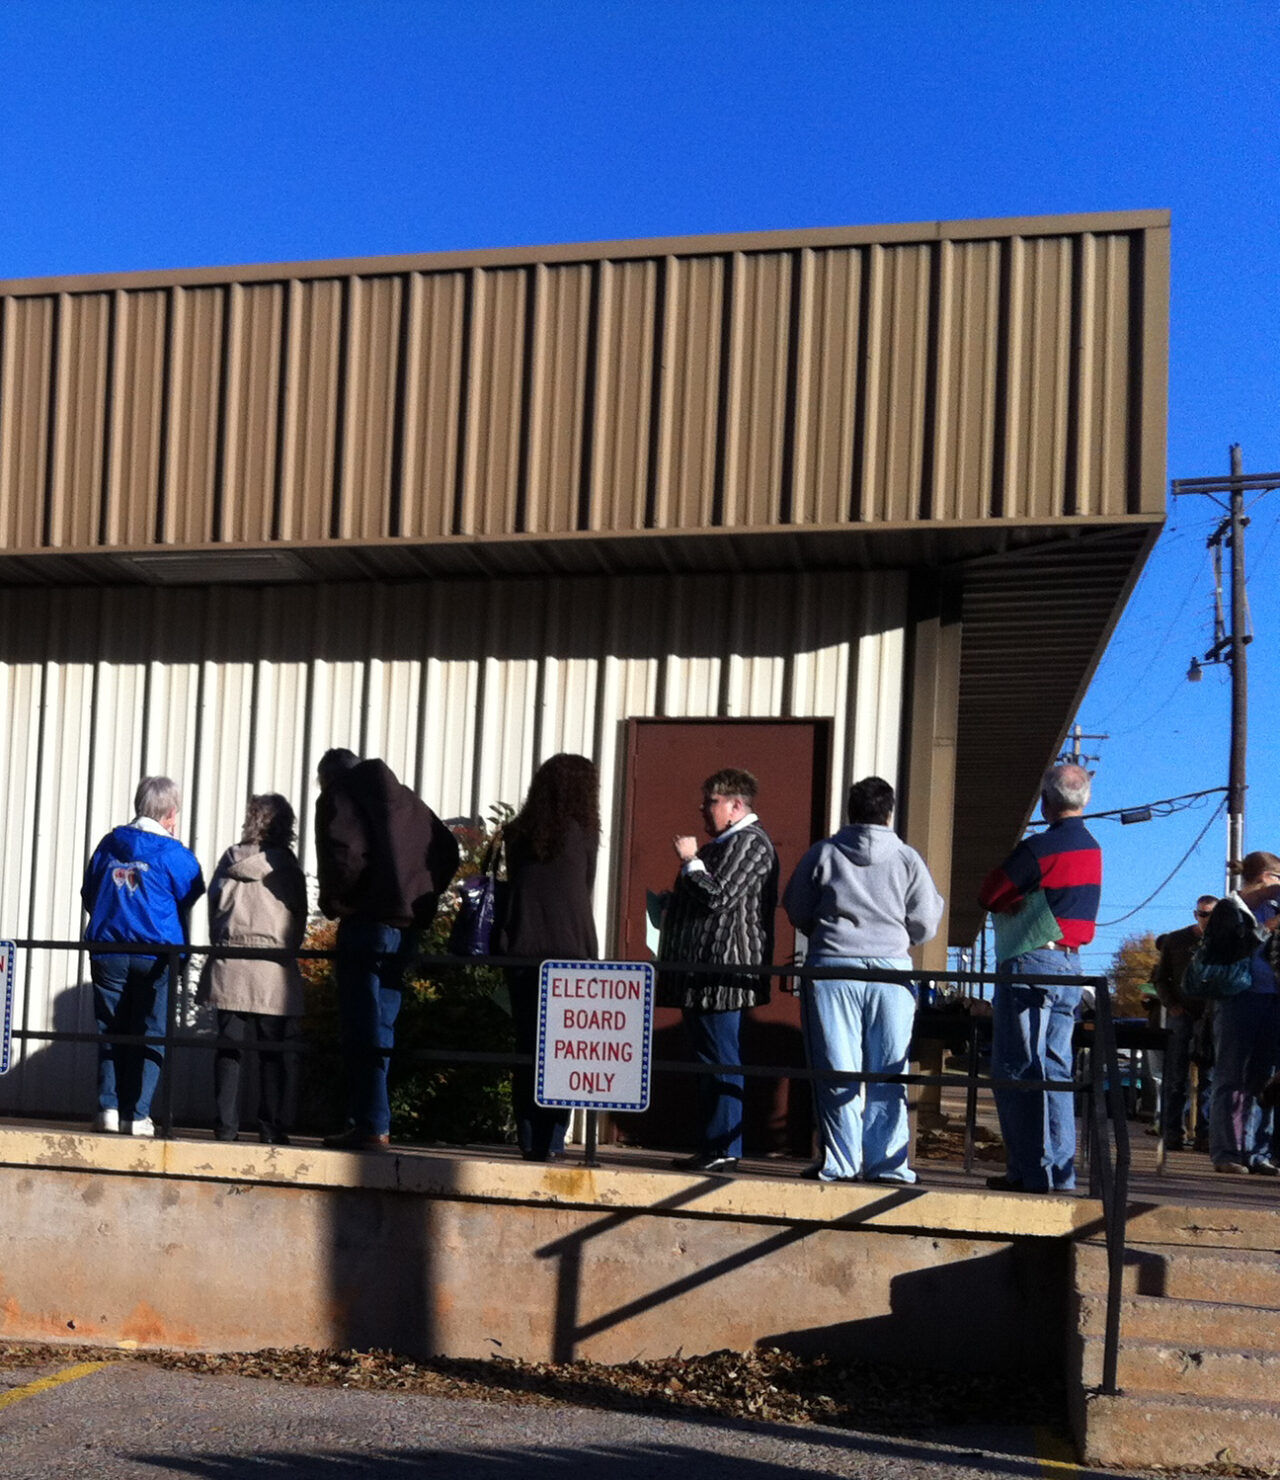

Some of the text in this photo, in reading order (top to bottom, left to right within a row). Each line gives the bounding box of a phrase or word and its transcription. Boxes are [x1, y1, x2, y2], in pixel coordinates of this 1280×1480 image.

[552, 978, 640, 1000] ELECTION
[563, 1009, 626, 1031] BOARD
[554, 1039, 633, 1063] PARKING
[569, 1071, 615, 1093] ONLY
